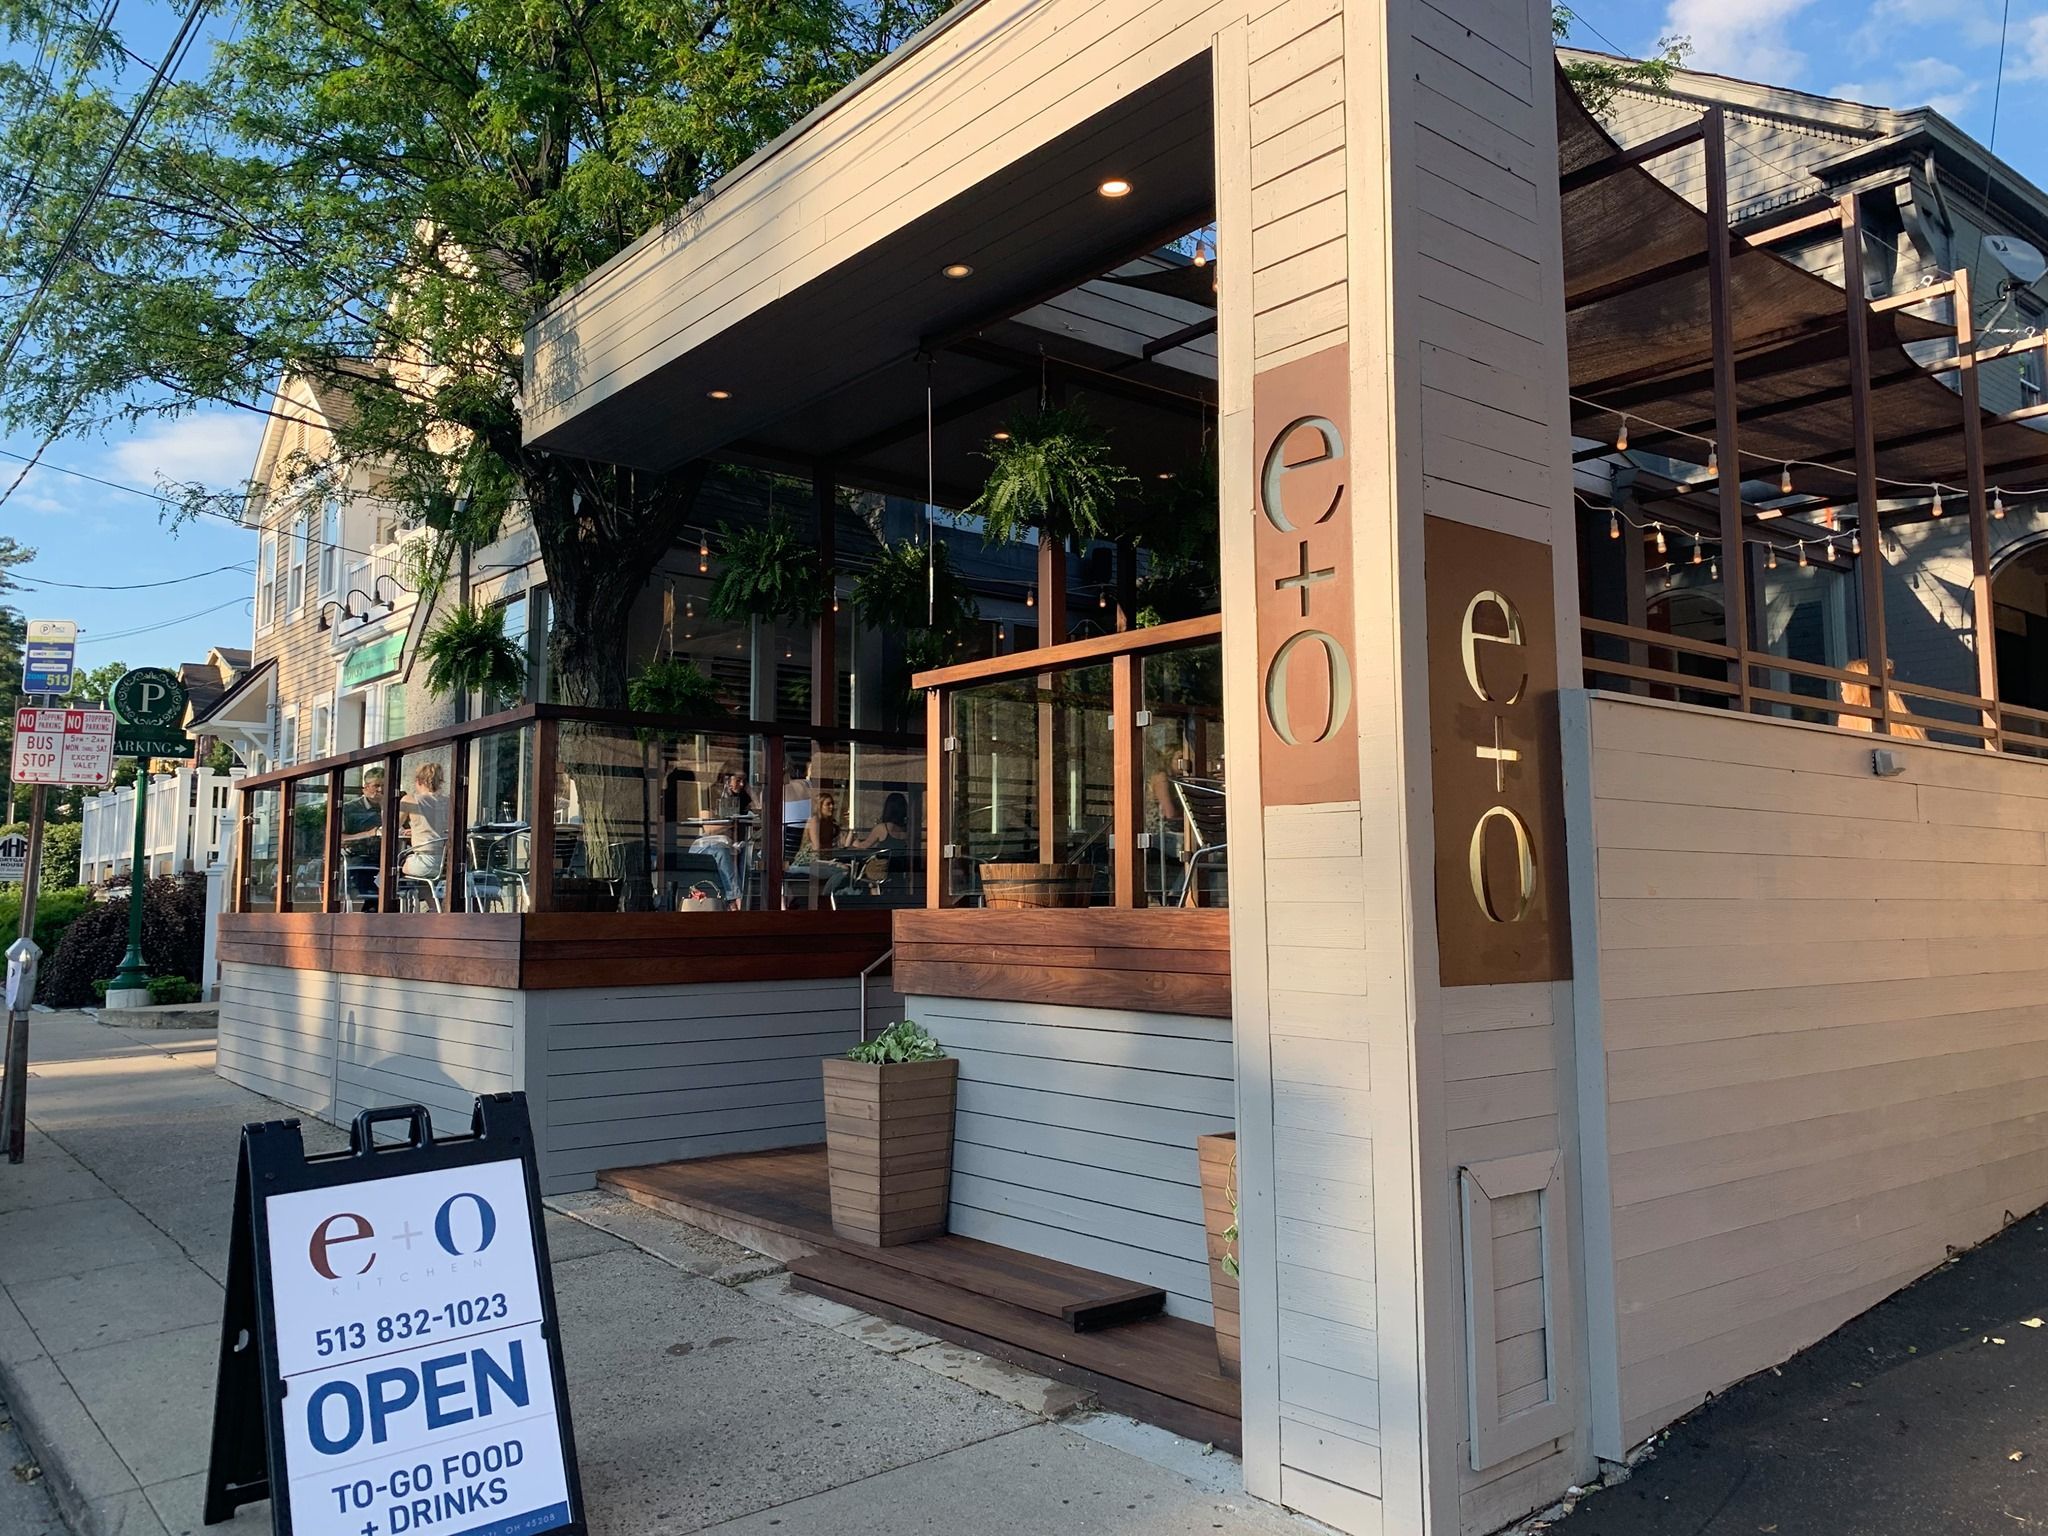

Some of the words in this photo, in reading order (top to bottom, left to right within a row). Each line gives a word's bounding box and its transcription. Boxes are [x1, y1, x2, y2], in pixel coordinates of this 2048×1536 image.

[47, 674, 70, 686] 513
[138, 682, 166, 713] P
[20, 713, 35, 728] NO
[38, 711, 64, 721] STOPPING
[67, 715, 82, 730] NO
[85, 714, 112, 723] STOPPING
[38, 721, 62, 730] PARKING
[85, 722, 110, 731] PARKING
[27, 735, 53, 750] BUS
[65, 743, 79, 752] MON
[96, 744, 108, 753] SAT
[113, 740, 172, 754] ARKING
[22, 753, 56, 768] STOP
[332, 1258, 483, 1296] KITCHEN
[315, 1322, 367, 1356] 513
[376, 1292, 508, 1343] 832-1023
[306, 1339, 530, 1456] OPEN
[331, 1463, 433, 1514] TO-GO
[442, 1439, 524, 1485] FOOD
[388, 1477, 508, 1535] DRINKS
[505, 1525, 521, 1535] OH
